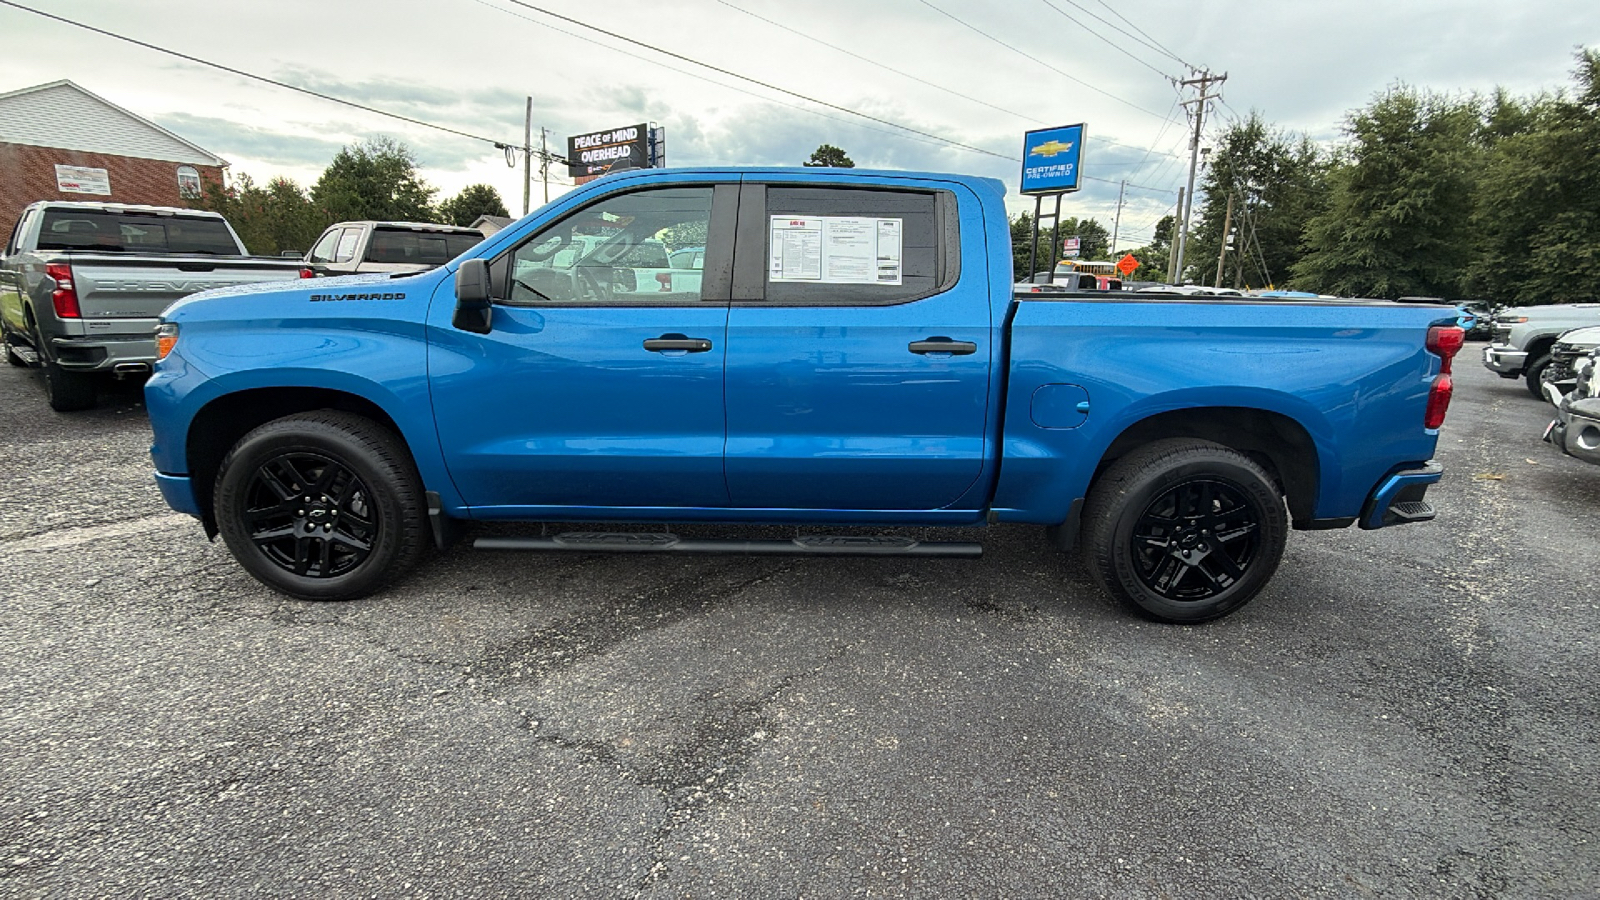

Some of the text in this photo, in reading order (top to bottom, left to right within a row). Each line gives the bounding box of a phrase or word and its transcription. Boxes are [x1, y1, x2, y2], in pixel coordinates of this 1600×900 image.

[575, 134, 602, 149] PEACE
[612, 128, 638, 142] MIND
[581, 145, 631, 162] OVERHEAD
[1026, 163, 1073, 174] CERTIFIED
[1027, 170, 1071, 179] PRE-OWNED
[309, 293, 406, 302] SILVERADO
